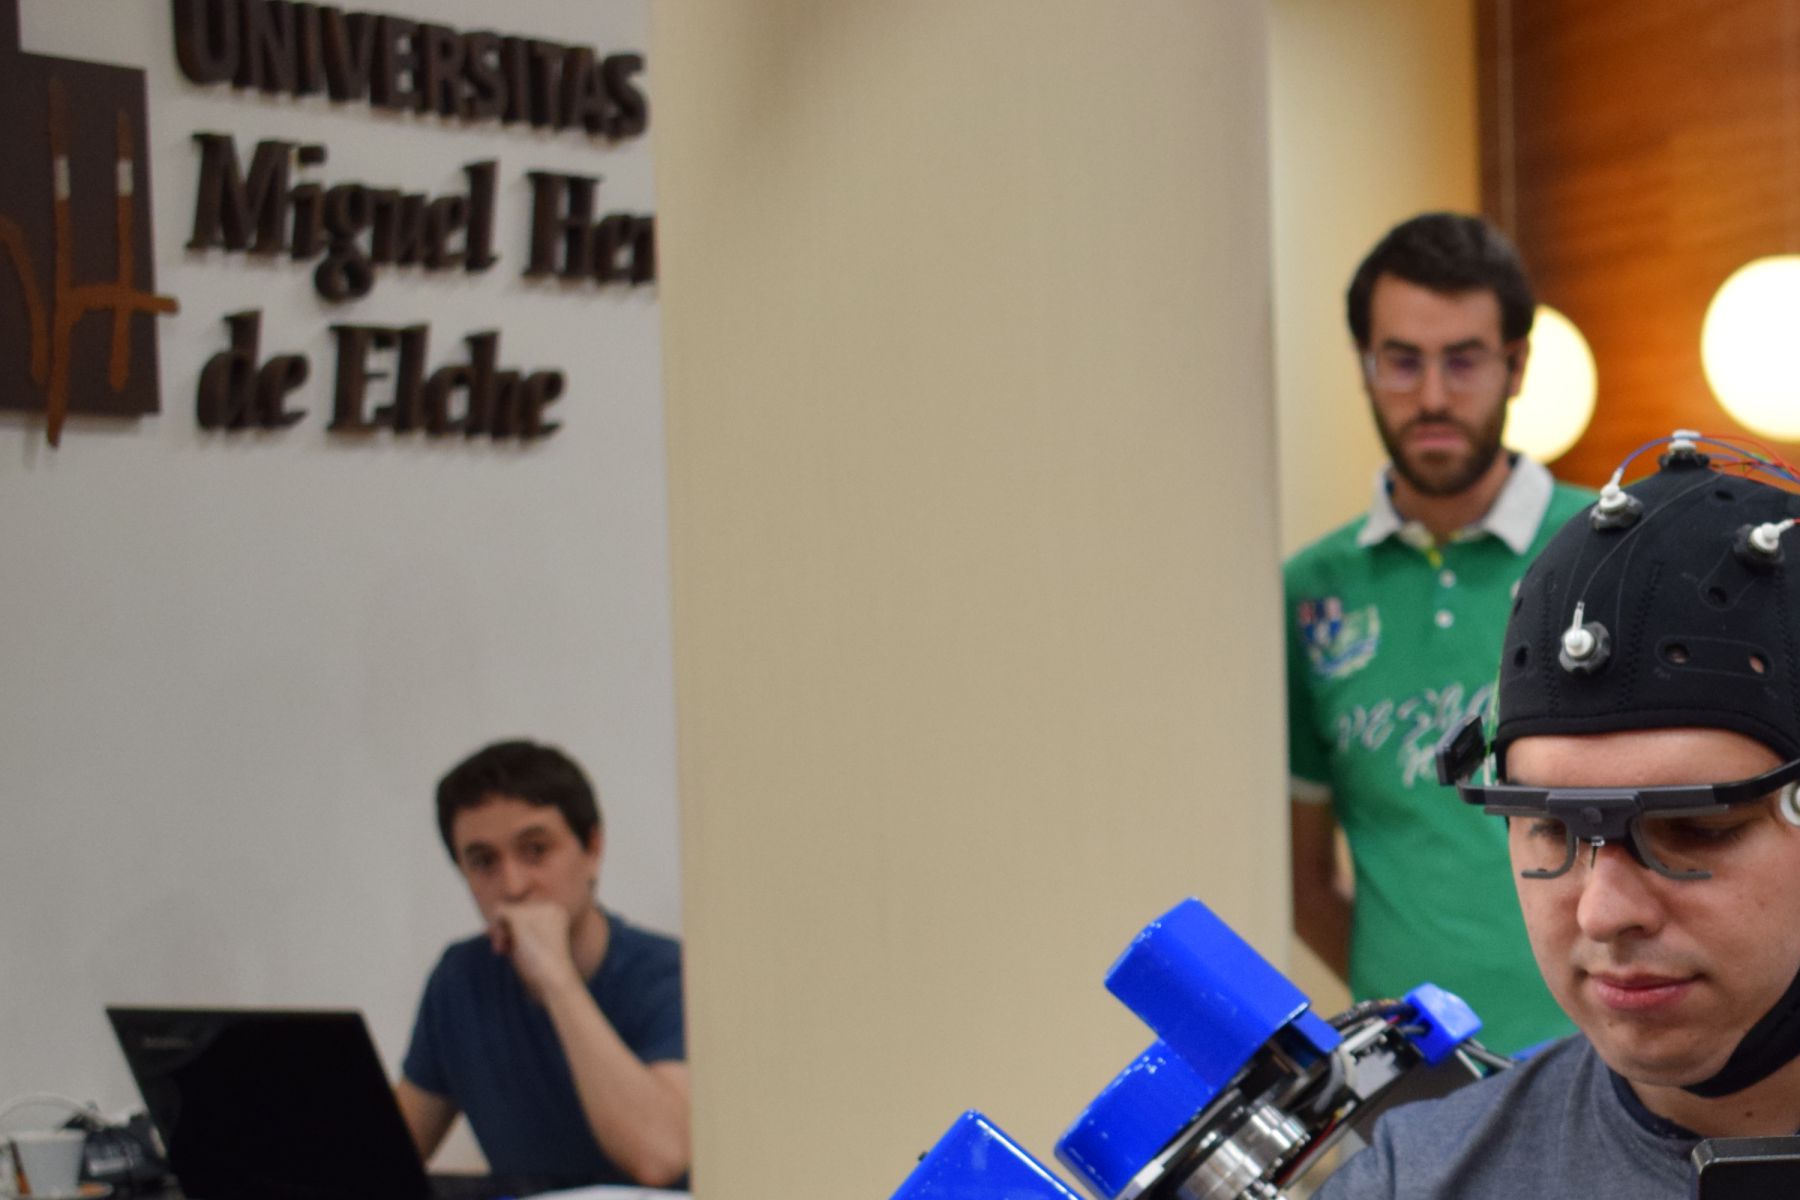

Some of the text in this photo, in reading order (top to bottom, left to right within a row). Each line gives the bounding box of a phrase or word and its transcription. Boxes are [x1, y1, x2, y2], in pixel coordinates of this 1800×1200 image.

[171, 0, 650, 140] UNIVERSITAS
[185, 132, 500, 301] Miguel
[197, 309, 565, 441] de Elche
